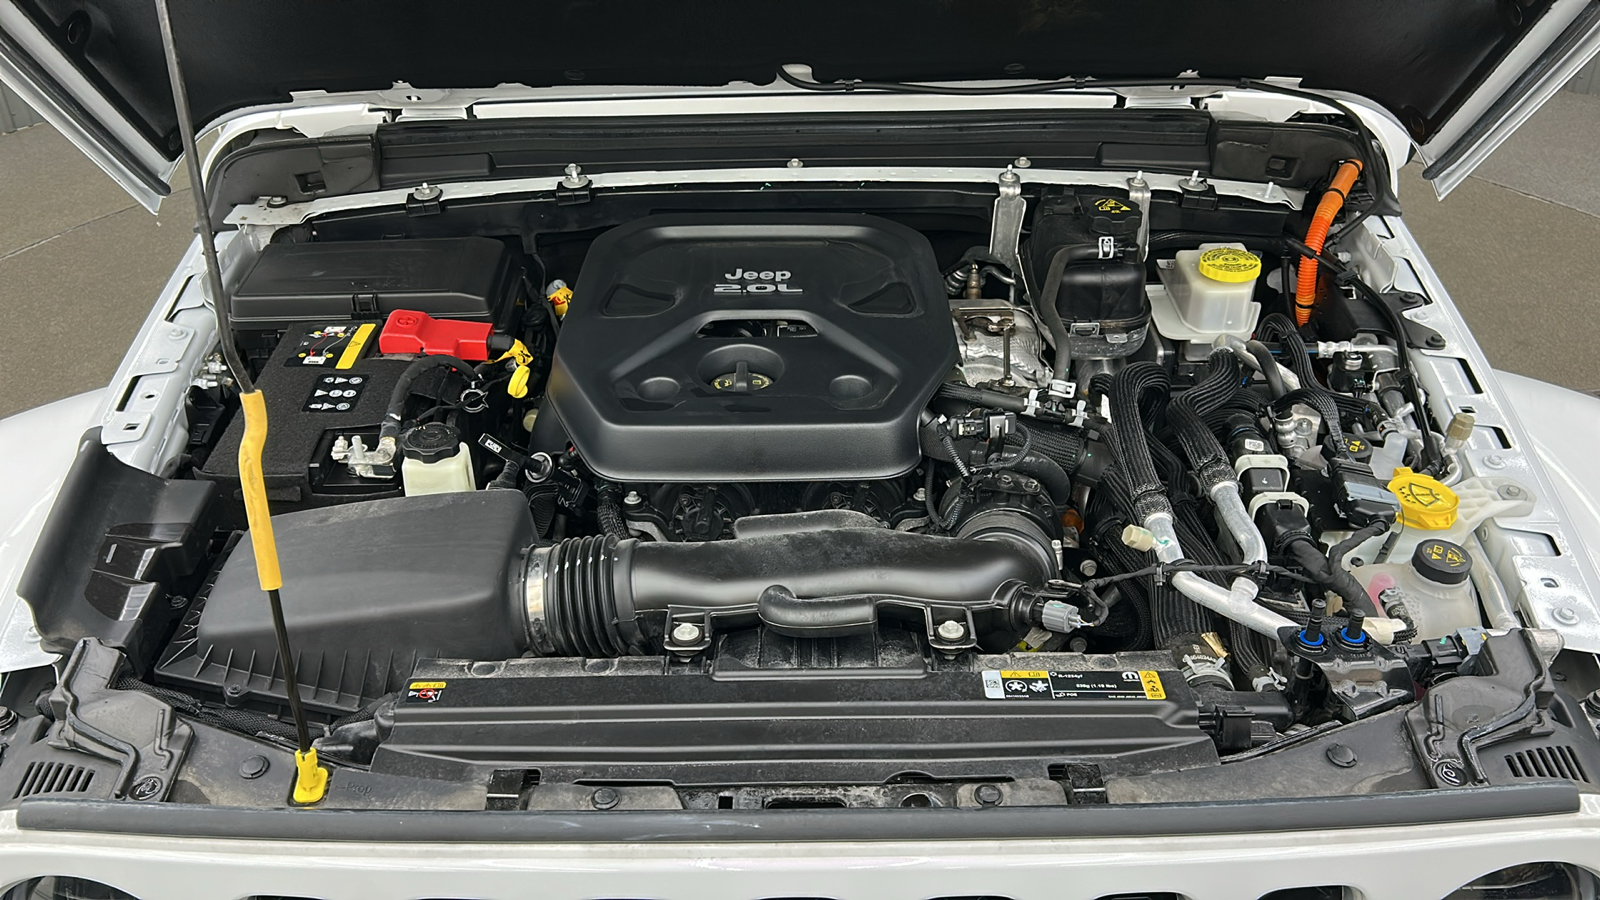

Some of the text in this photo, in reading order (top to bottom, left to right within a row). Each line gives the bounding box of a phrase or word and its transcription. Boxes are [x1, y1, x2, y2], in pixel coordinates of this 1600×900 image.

[724, 268, 792, 282] Jeep
[713, 283, 803, 294] 2.0L
[346, 781, 372, 796] Prop
